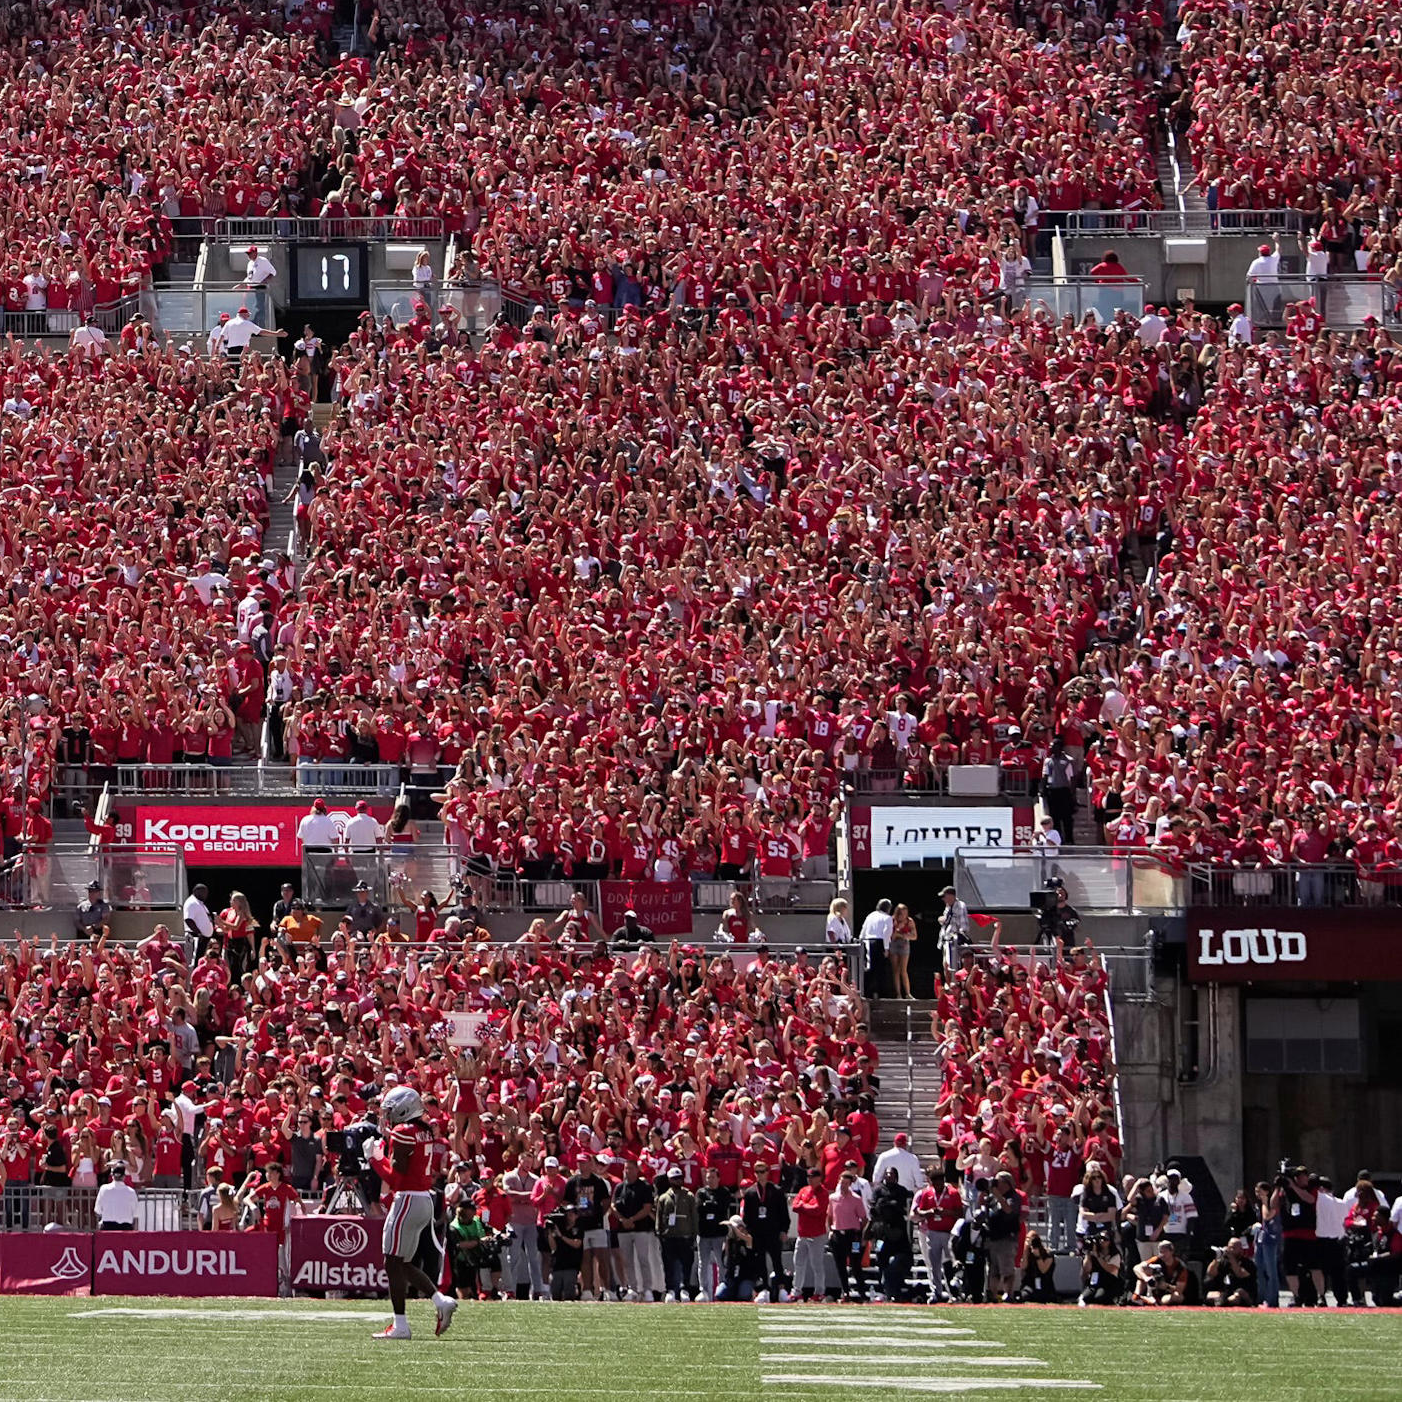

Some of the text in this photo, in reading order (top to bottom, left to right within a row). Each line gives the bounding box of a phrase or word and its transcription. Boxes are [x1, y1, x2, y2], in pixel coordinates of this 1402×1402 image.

[321, 254, 350, 291] 17
[115, 823, 133, 838] 39
[144, 819, 279, 841] Koorsen
[852, 825, 869, 840] 37
[1014, 825, 1032, 841] 35
[184, 841, 195, 852] &
[203, 841, 279, 852] SECURITY
[1198, 929, 1308, 965] LOUD
[97, 1250, 248, 1276] ANDURIL
[293, 1260, 390, 1288] Allstate
